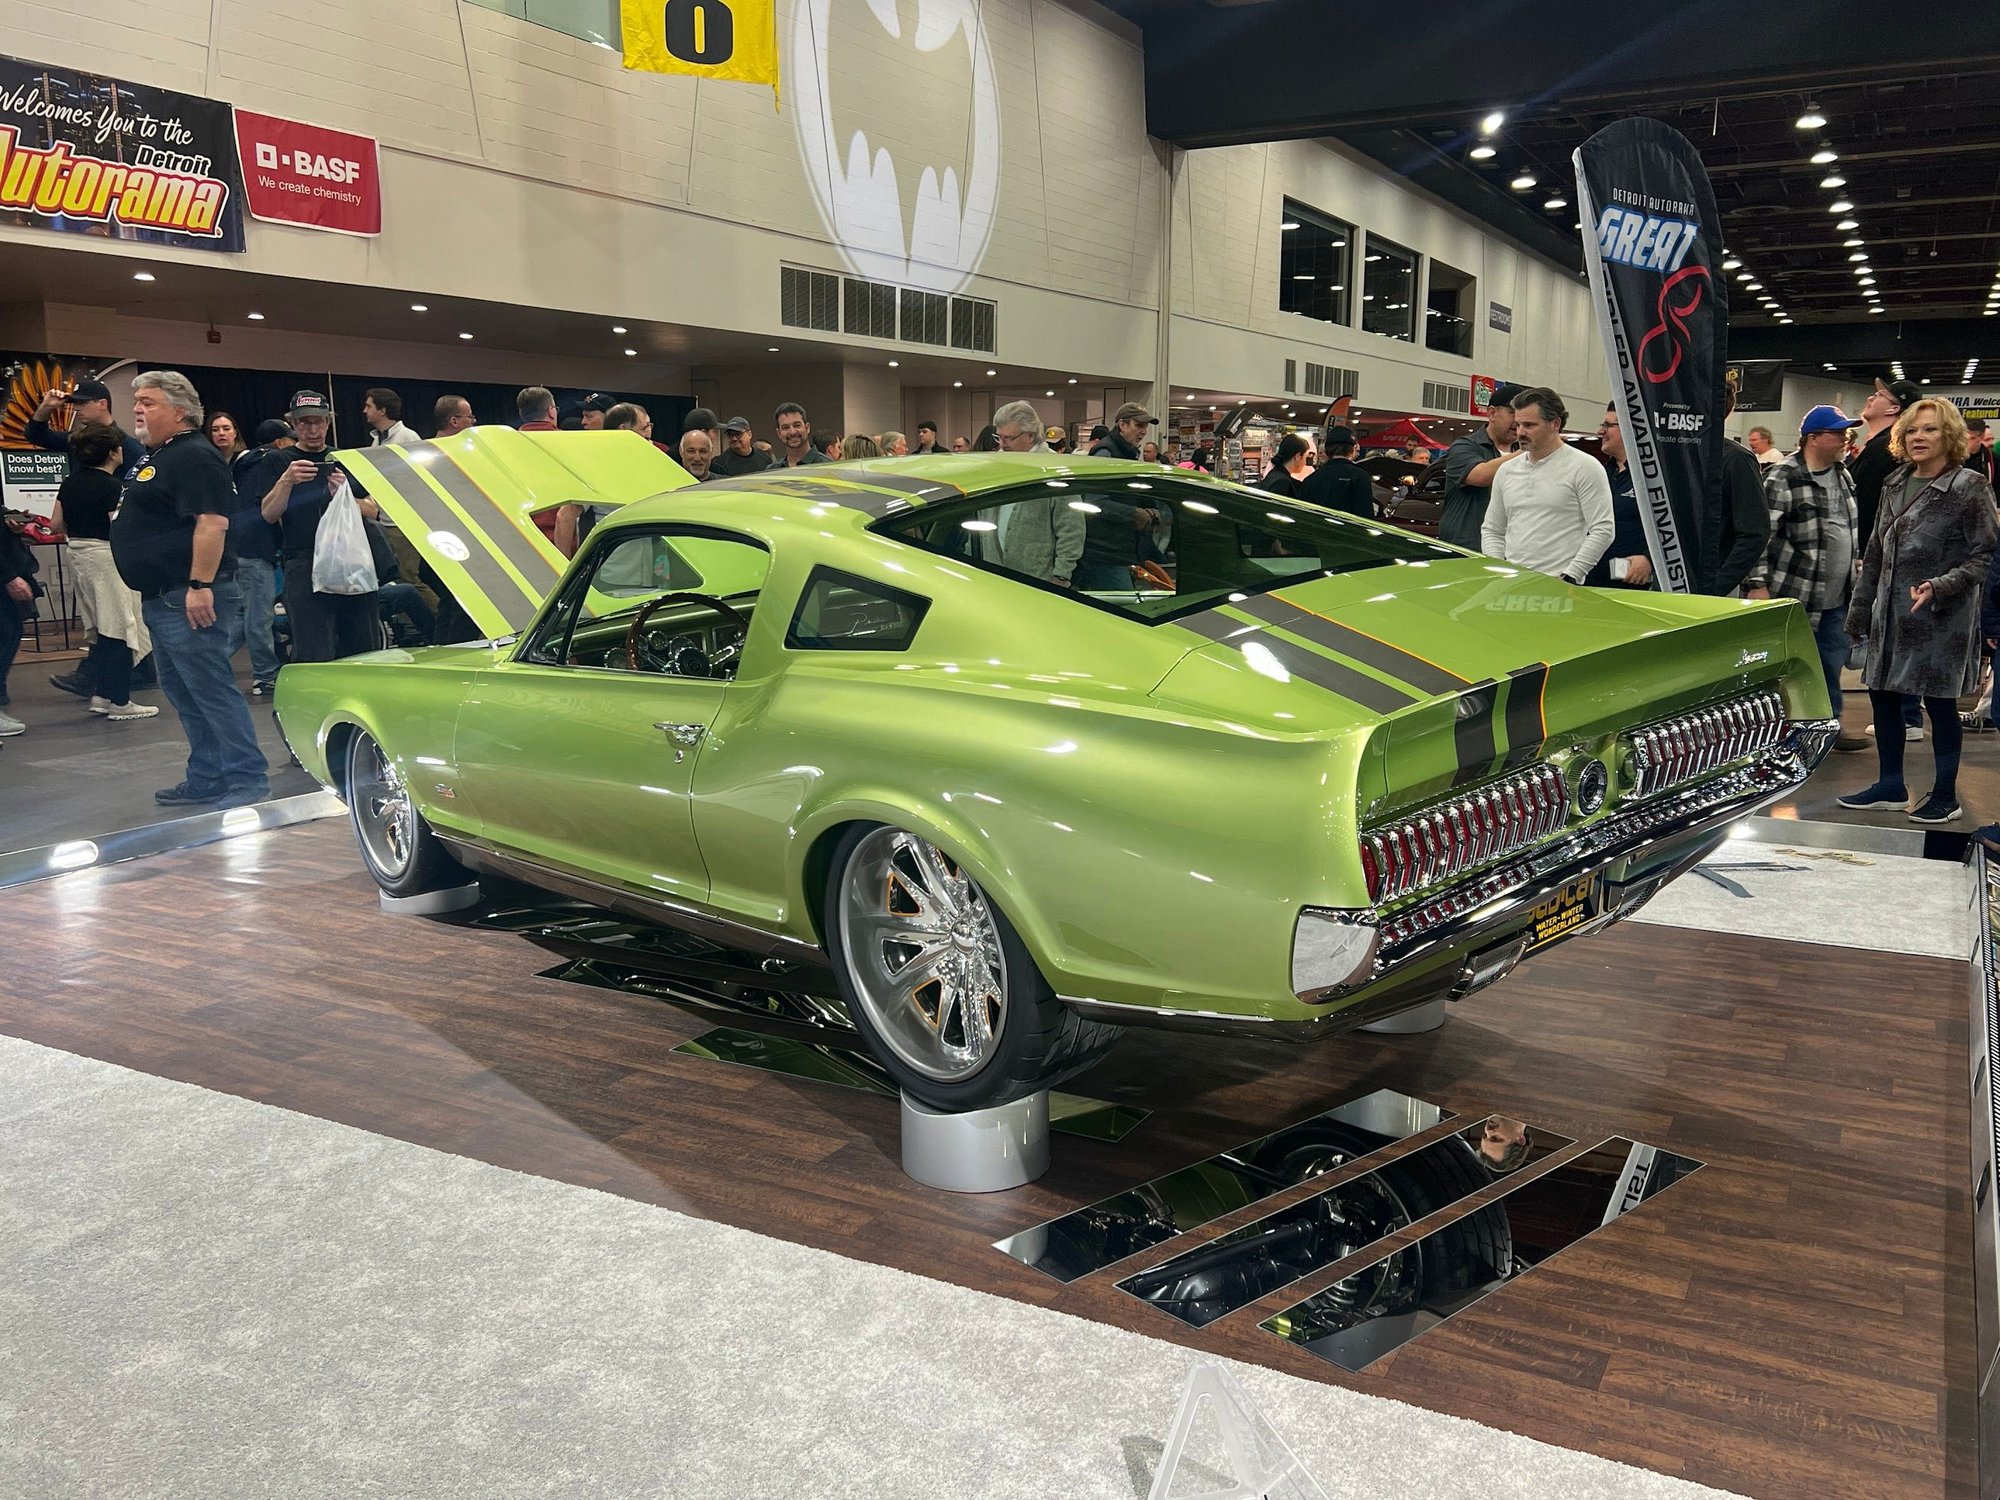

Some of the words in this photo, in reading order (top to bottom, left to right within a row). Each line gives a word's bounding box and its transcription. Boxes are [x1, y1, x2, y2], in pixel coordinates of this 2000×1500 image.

[0, 83, 93, 127] Welcomes
[95, 105, 136, 144] You
[137, 113, 157, 138] to
[160, 117, 194, 145] the
[138, 147, 211, 176] Detroit
[294, 149, 360, 184] BASF
[258, 174, 276, 189] We
[278, 181, 311, 195] create
[313, 186, 361, 207] chemistry
[1612, 187, 1647, 208] DETROIT
[1649, 197, 1695, 216] AUTORAMA
[1597, 206, 1699, 273] GREAT
[1667, 413, 1704, 431] BASF
[7, 454, 32, 464] Does
[34, 454, 66, 464] Detroit
[9, 464, 34, 473] know
[36, 464, 62, 473] best?
[1622, 380, 1659, 479] AWARD
[1648, 485, 1688, 594] FINALIST
